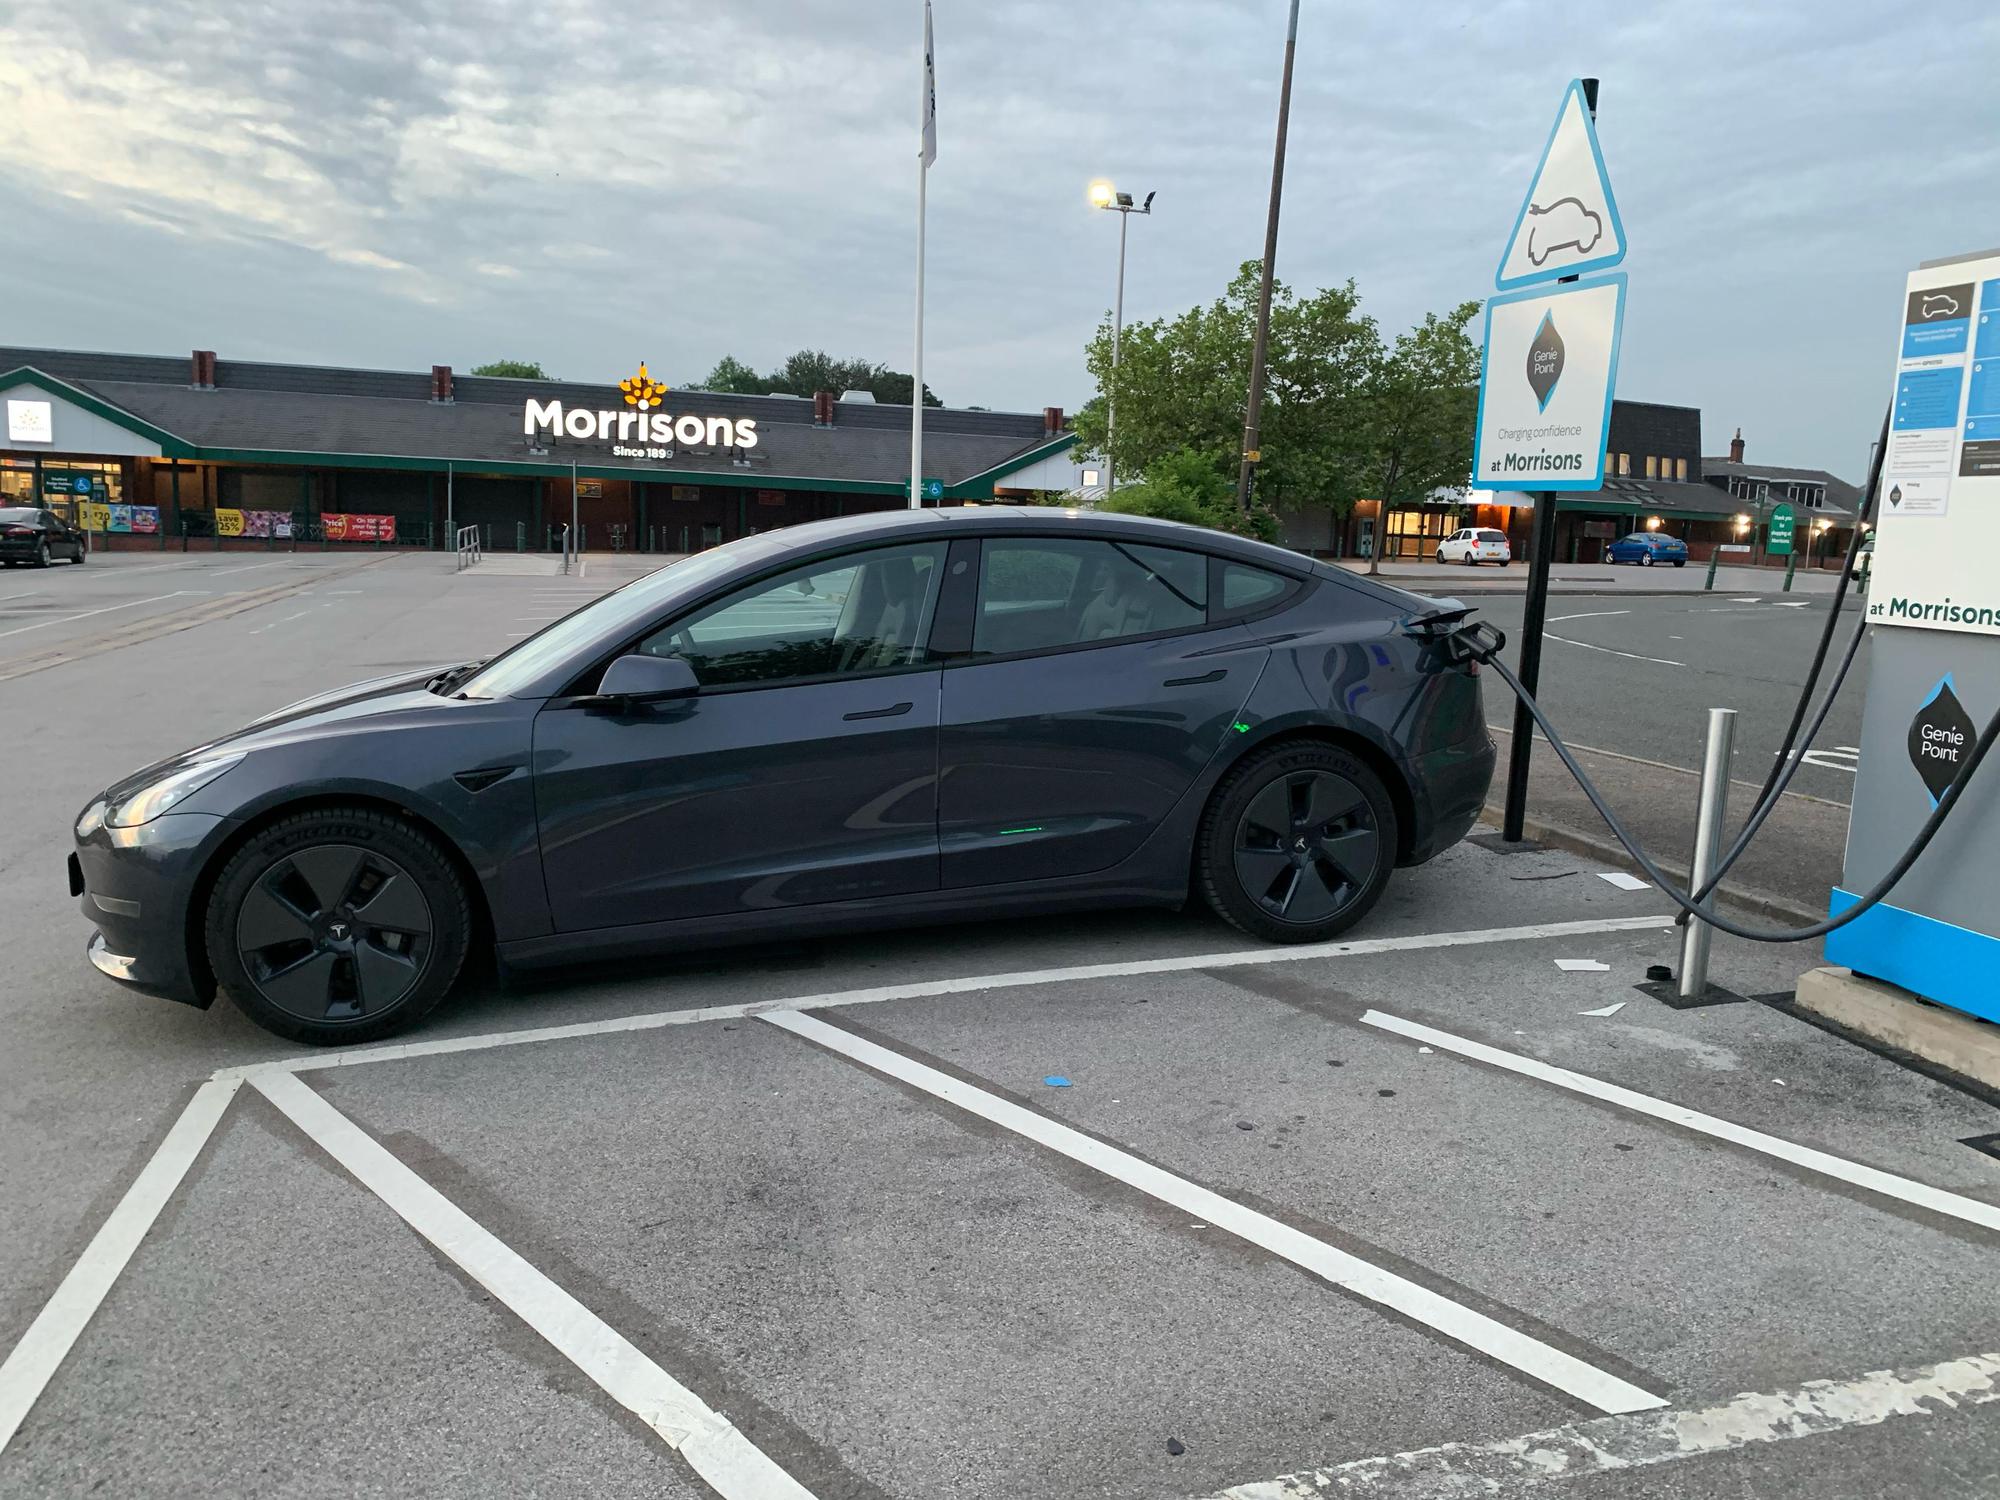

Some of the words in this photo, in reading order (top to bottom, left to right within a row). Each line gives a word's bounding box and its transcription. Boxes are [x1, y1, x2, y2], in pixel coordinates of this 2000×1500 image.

[1533, 346, 1558, 363] Genie
[1534, 362, 1555, 375] Point
[524, 398, 758, 448] Morrisons
[1498, 427, 1533, 442] Charging
[1533, 424, 1582, 438] confidence
[612, 445, 645, 458] Since
[646, 447, 674, 459] 1899
[1491, 459, 1501, 472] at
[1504, 448, 1583, 471] Morrisons
[219, 521, 240, 531] 25%
[1870, 602, 1884, 615] at
[1921, 724, 1964, 745] Genie
[1921, 740, 1959, 762] Point
